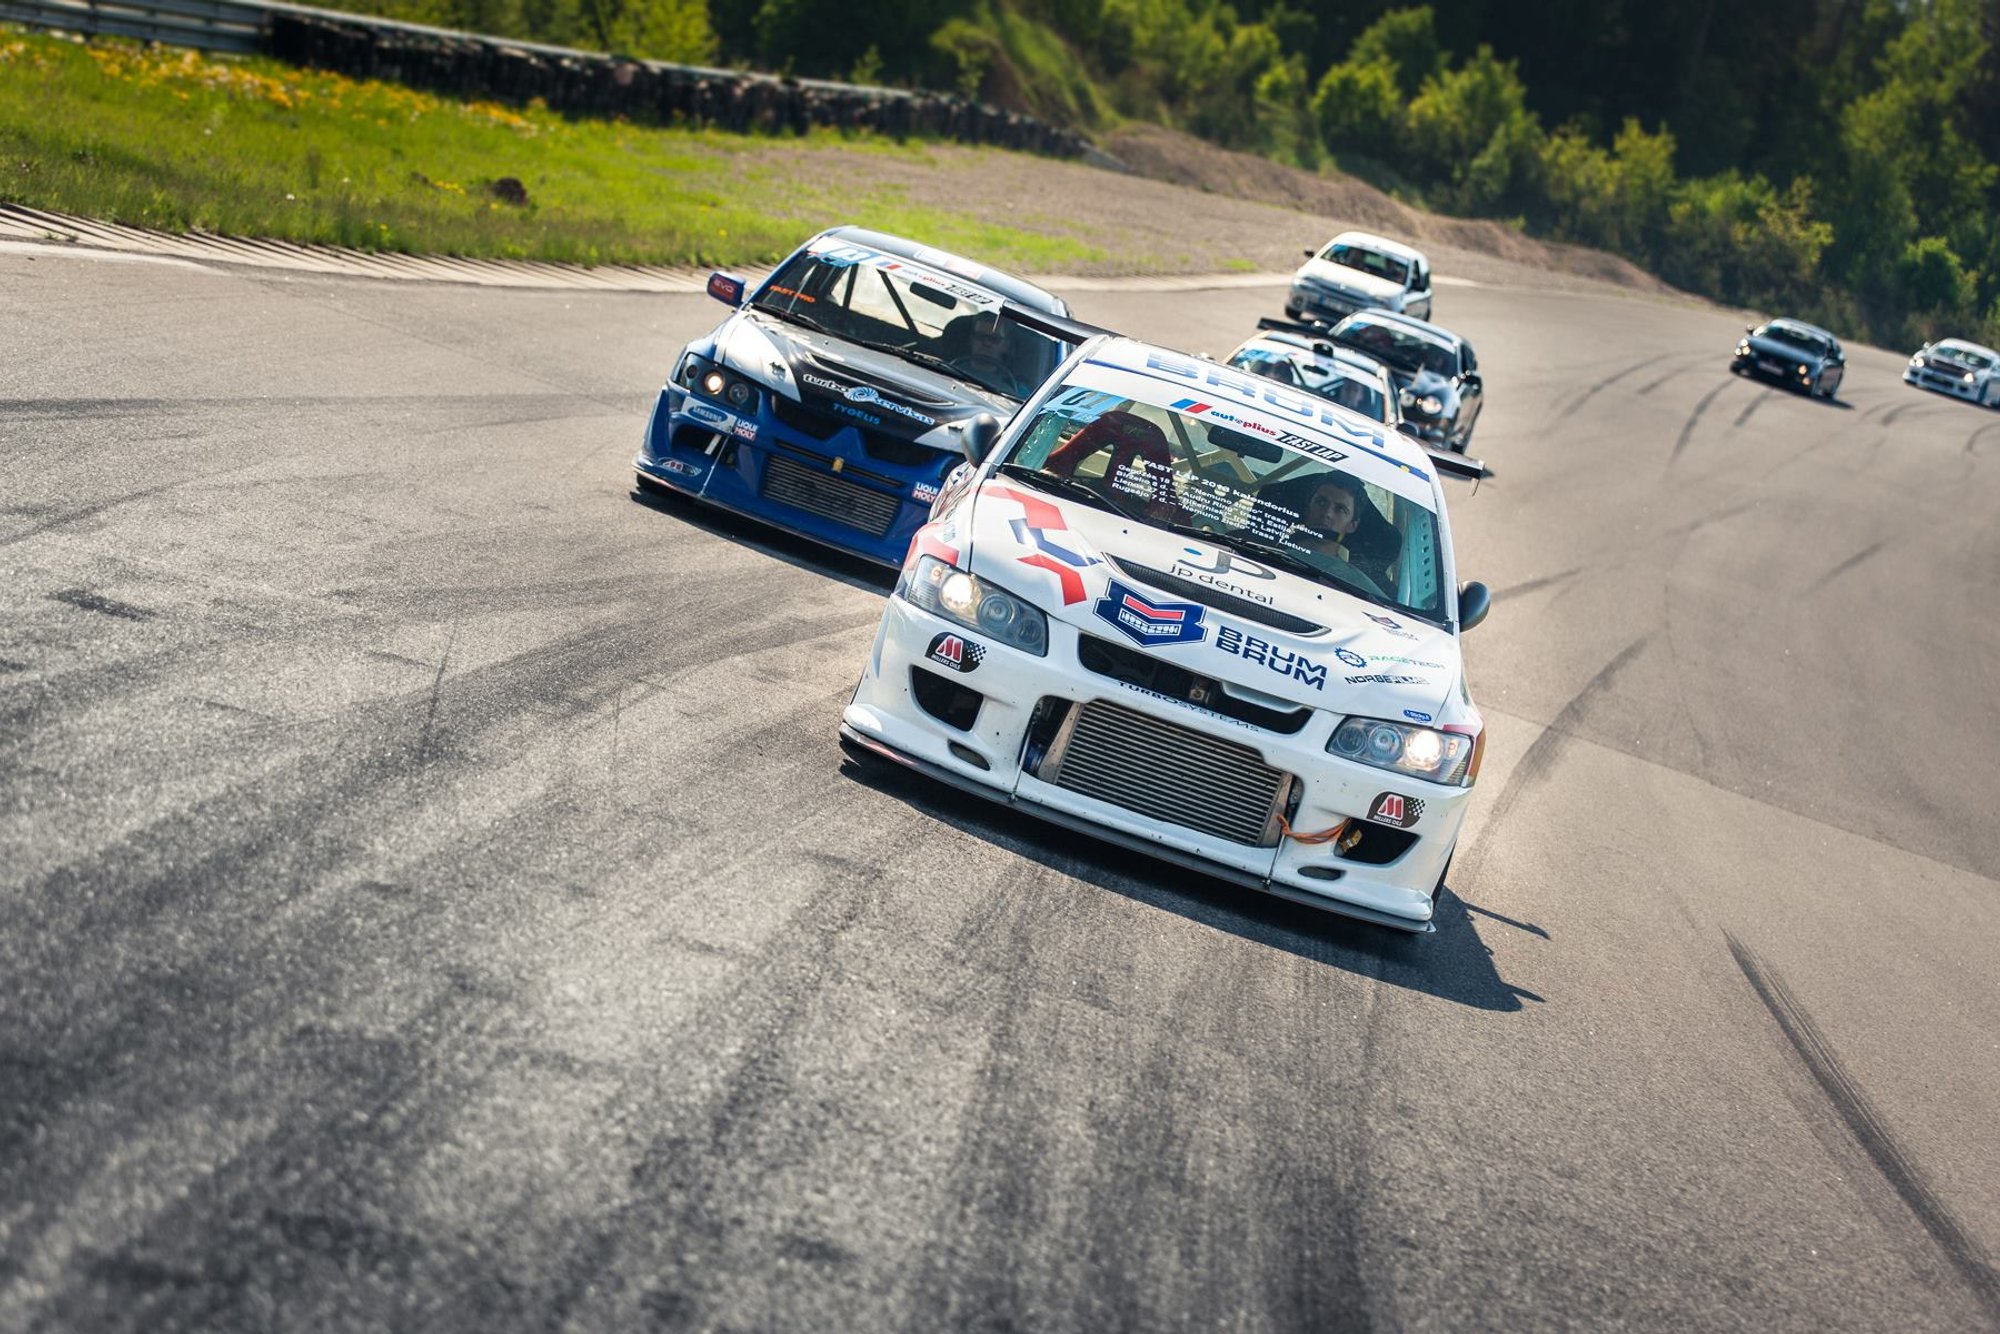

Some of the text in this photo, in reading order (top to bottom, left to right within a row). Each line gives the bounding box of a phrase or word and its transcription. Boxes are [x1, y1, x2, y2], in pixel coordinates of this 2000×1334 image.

[712, 278, 735, 294] EVO
[802, 373, 849, 394] turbo
[734, 426, 756, 441] MOLY
[1210, 410, 1277, 437] autoplius
[1282, 434, 1341, 461] FAST LAP
[1143, 459, 1173, 473] FAST
[1175, 469, 1199, 481] LAP
[1233, 489, 1300, 518] kalendorius
[1260, 524, 1290, 540] Latvija
[1291, 522, 1324, 539] Lietuva
[1278, 538, 1312, 555] Lietuva
[1169, 564, 1274, 605] jp dental
[1216, 636, 1325, 691] BRUM
[1219, 625, 1328, 678] BRUM
